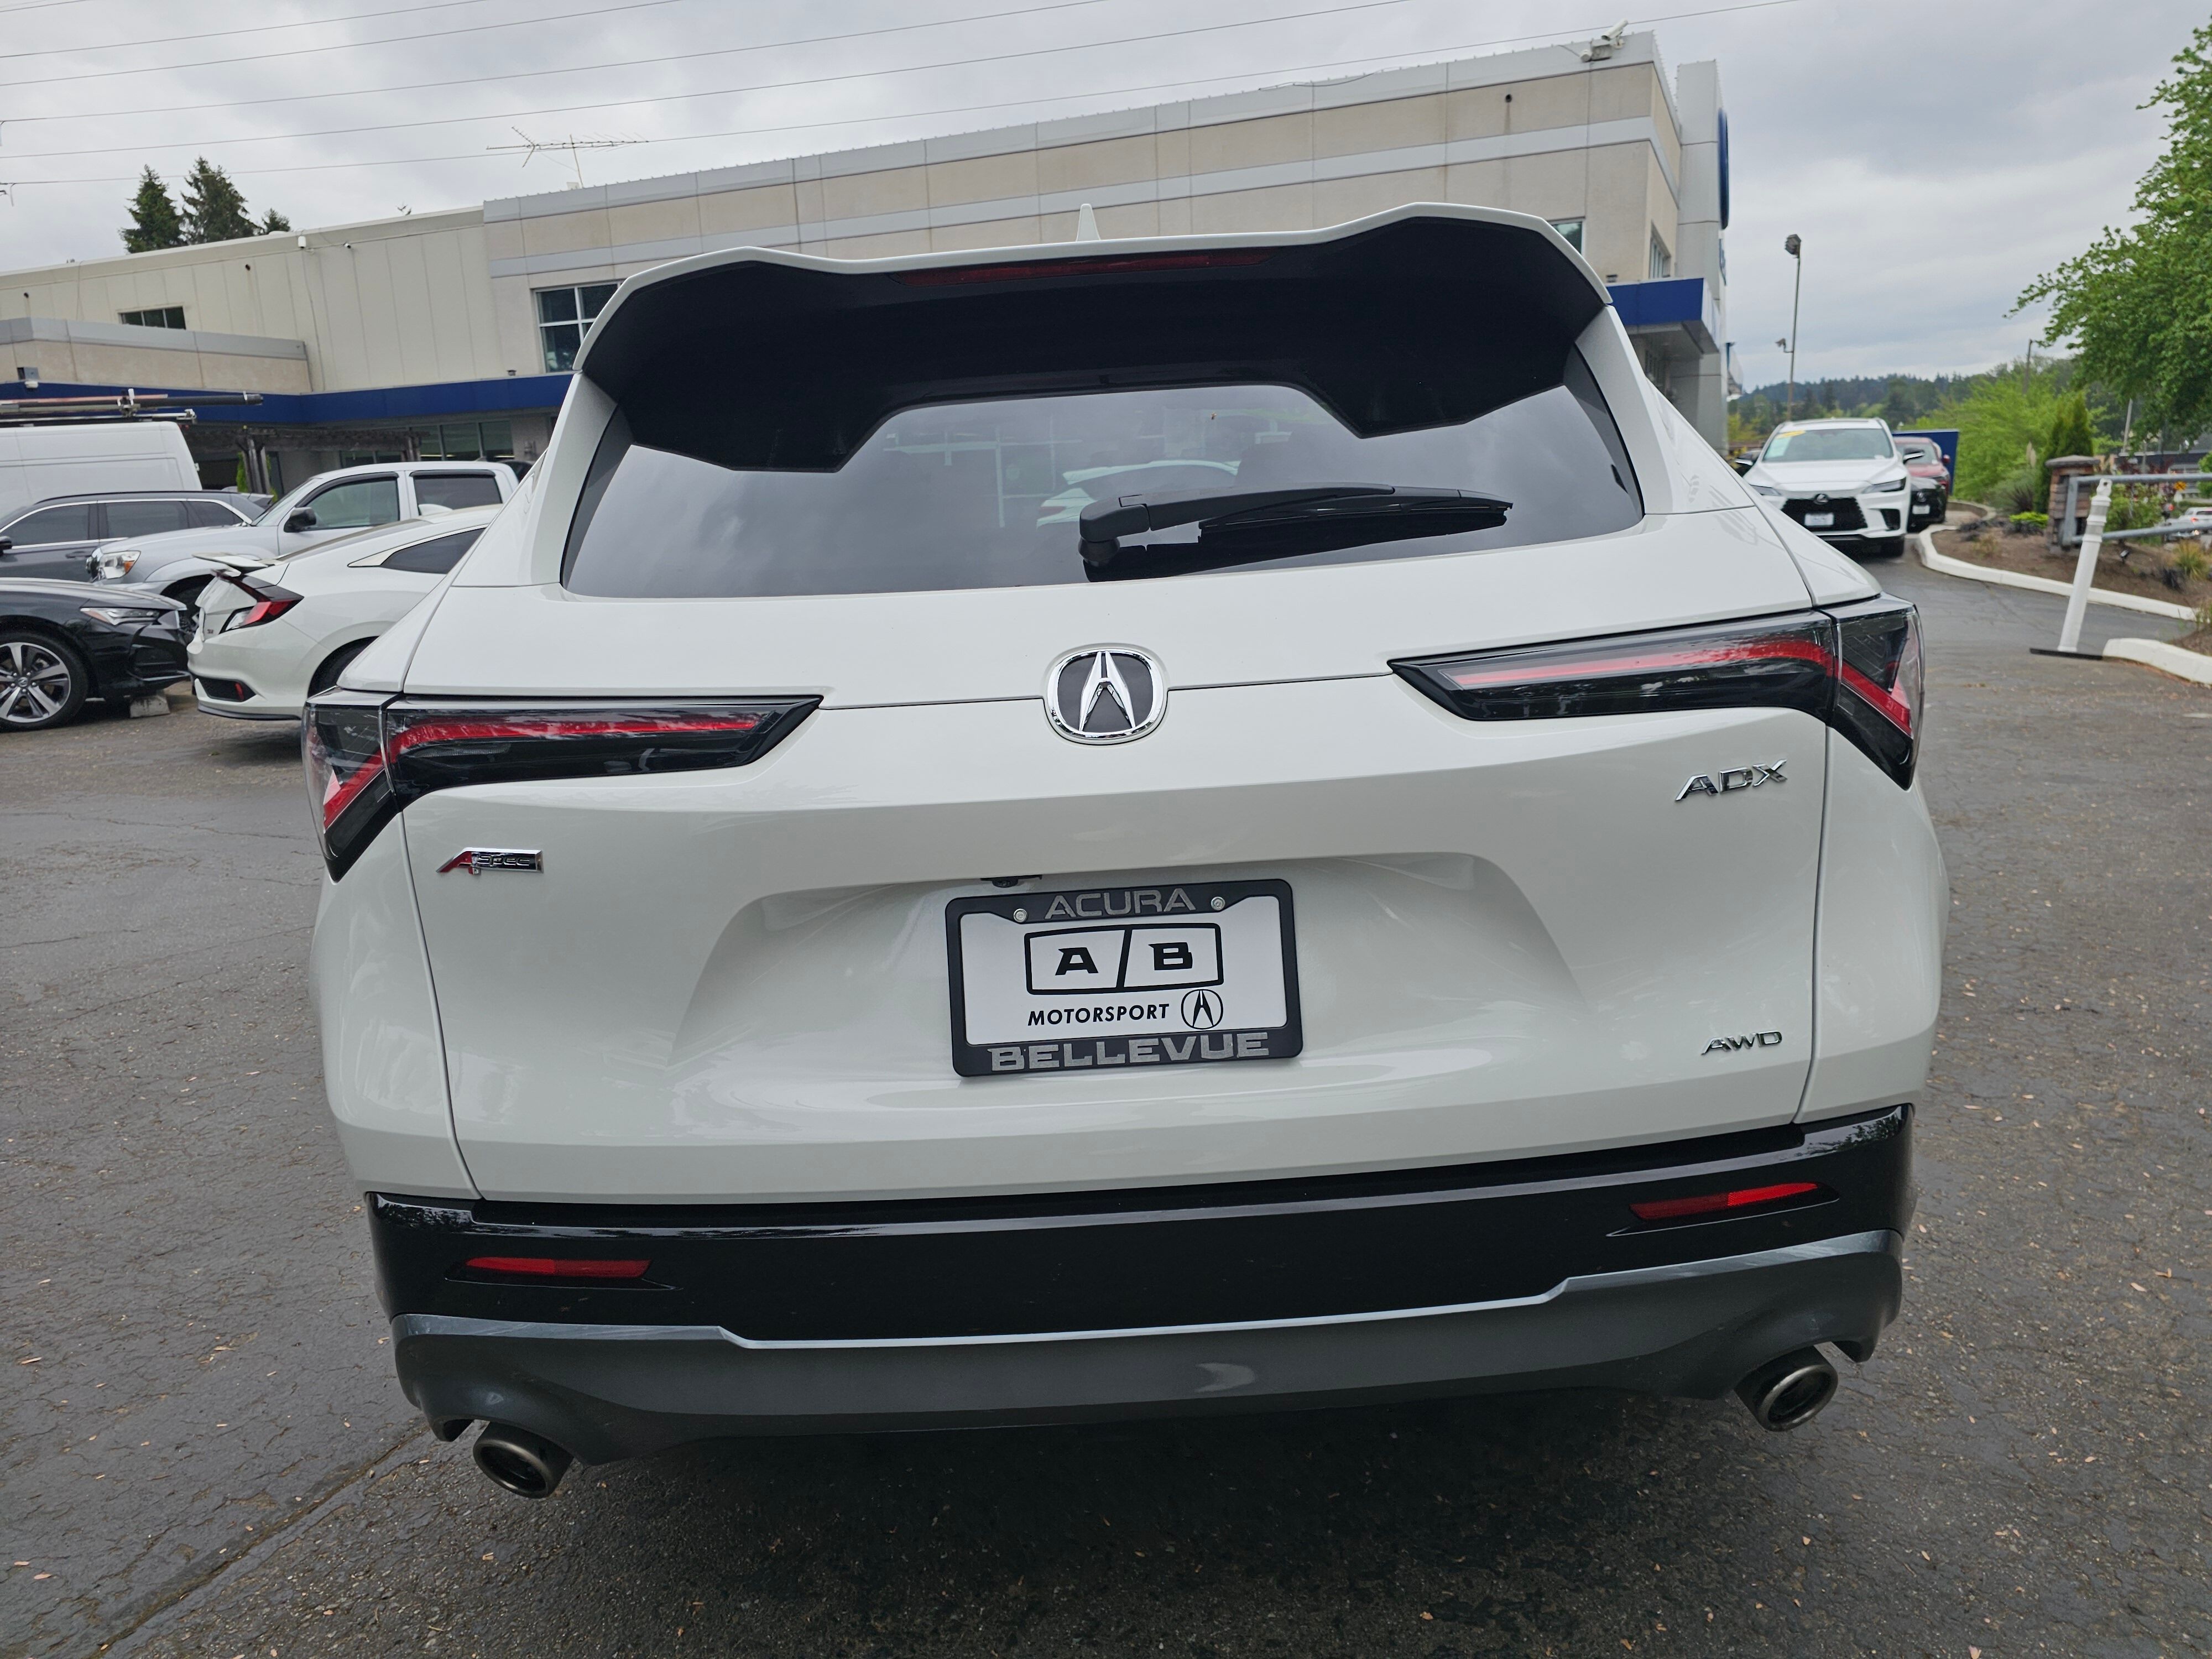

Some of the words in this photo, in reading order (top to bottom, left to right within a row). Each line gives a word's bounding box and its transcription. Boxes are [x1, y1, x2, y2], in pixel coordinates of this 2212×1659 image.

[1674, 759, 1787, 801] ADX
[1045, 888, 1196, 919] ACURA
[1027, 1004, 1170, 1026] MOTORSPORT
[987, 1032, 1269, 1072] BELLEVUE
[1701, 1030, 1783, 1055] AWD
